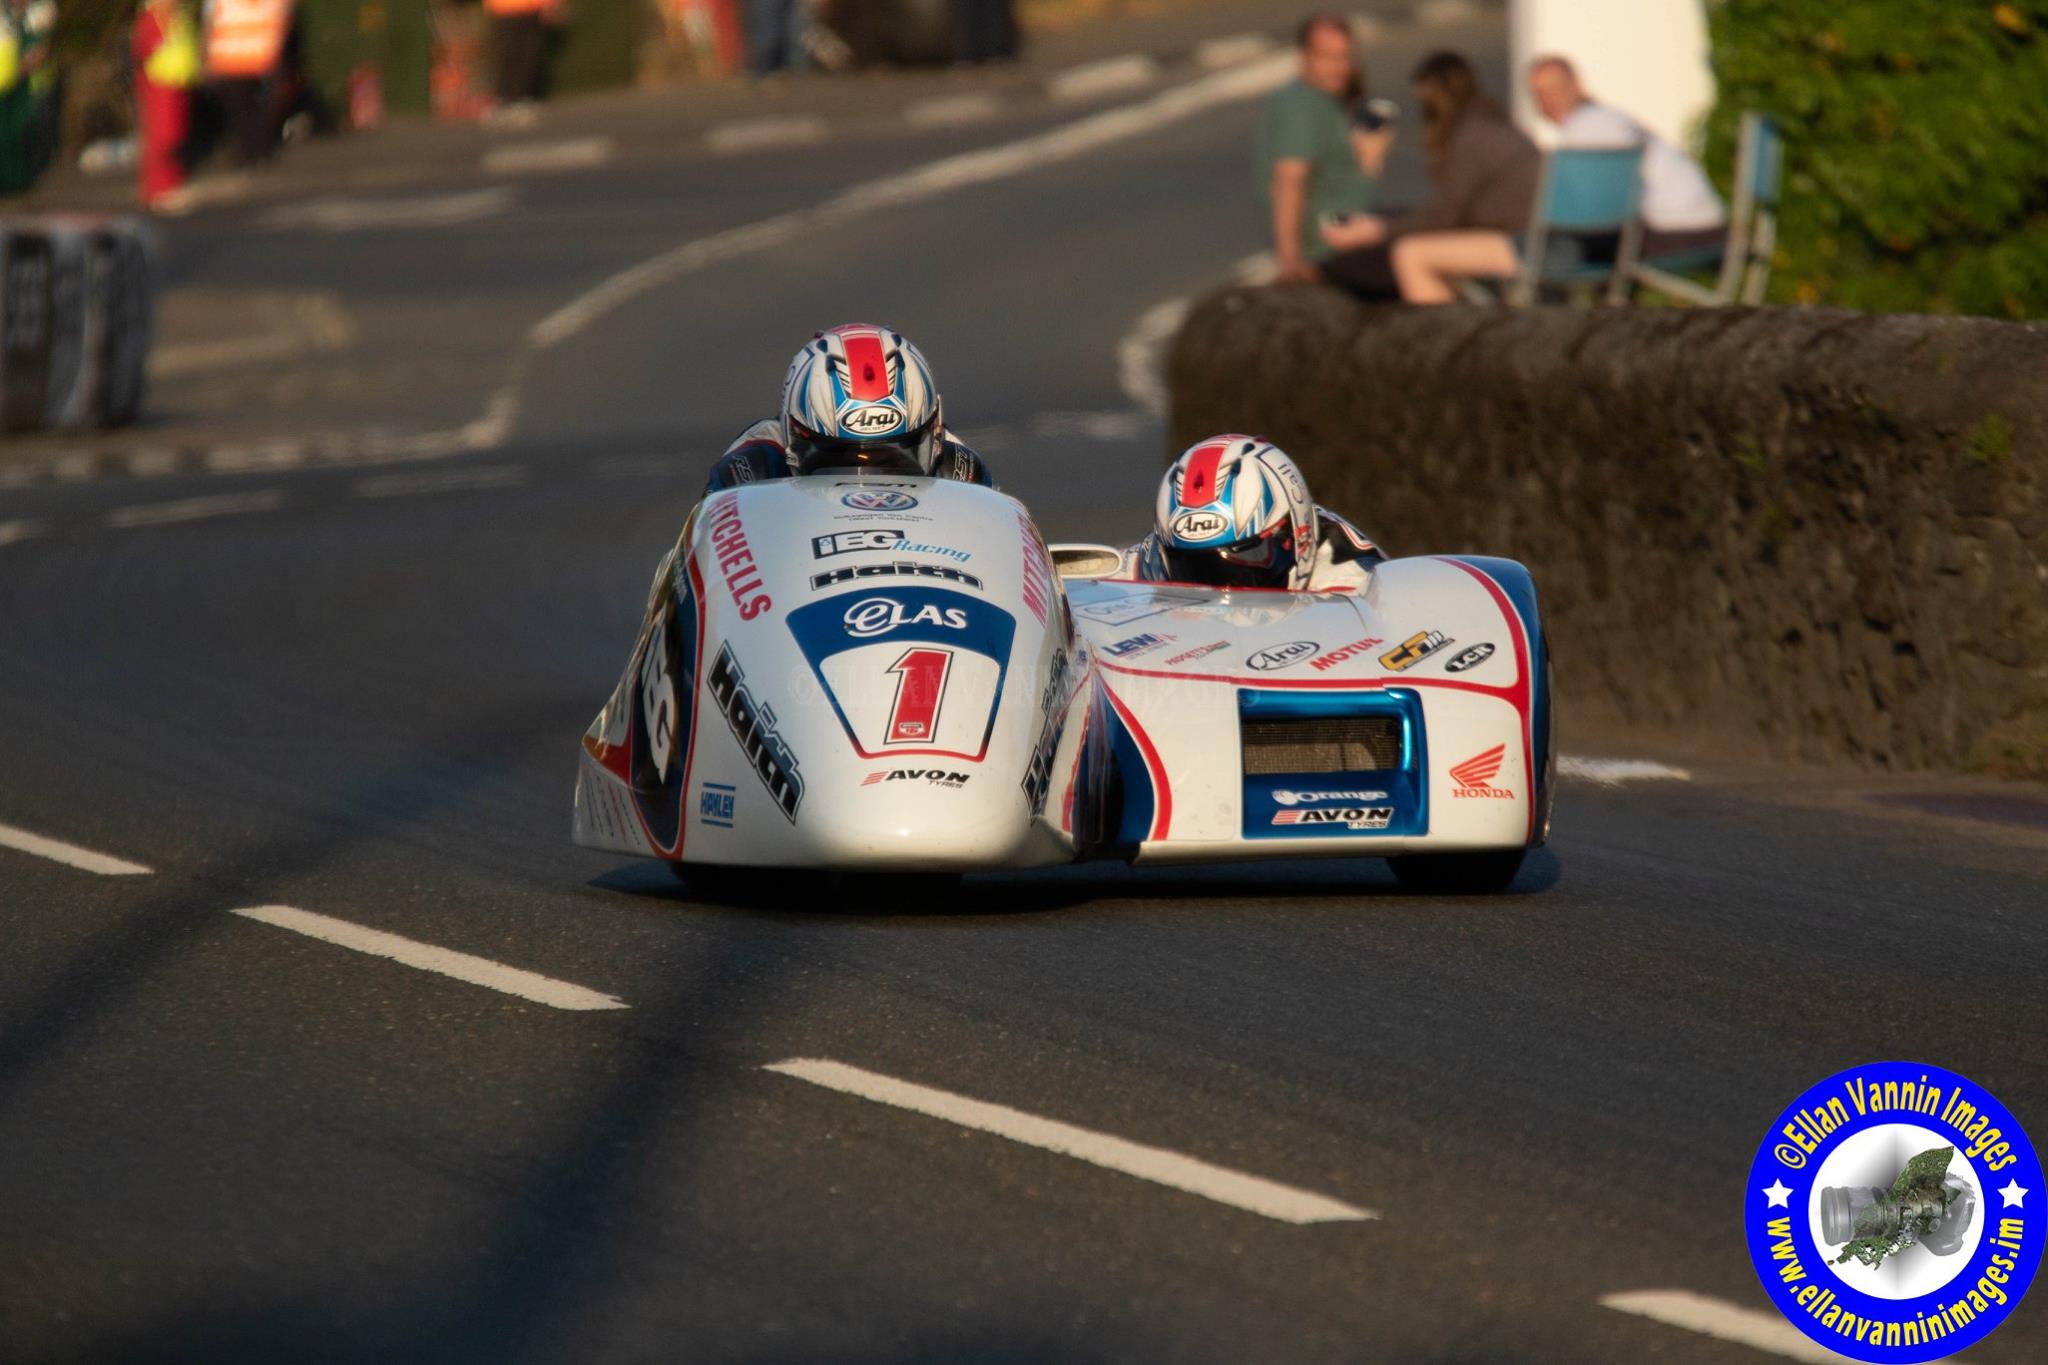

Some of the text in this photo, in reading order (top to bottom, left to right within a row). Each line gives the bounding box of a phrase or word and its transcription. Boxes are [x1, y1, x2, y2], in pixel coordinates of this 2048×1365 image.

[845, 409, 897, 427] Arai
[1175, 516, 1220, 534] Arai
[890, 539, 972, 563] Racing
[1258, 641, 1311, 669] Arai
[1309, 637, 1385, 671] MOTUL
[885, 647, 954, 745] 1
[885, 770, 970, 783] AVON
[927, 781, 963, 789] TYRES
[1298, 789, 1388, 802] Orange
[1451, 789, 1515, 799] HONDA
[1301, 808, 1392, 822] AVON
[1349, 821, 1387, 829] TYRES
